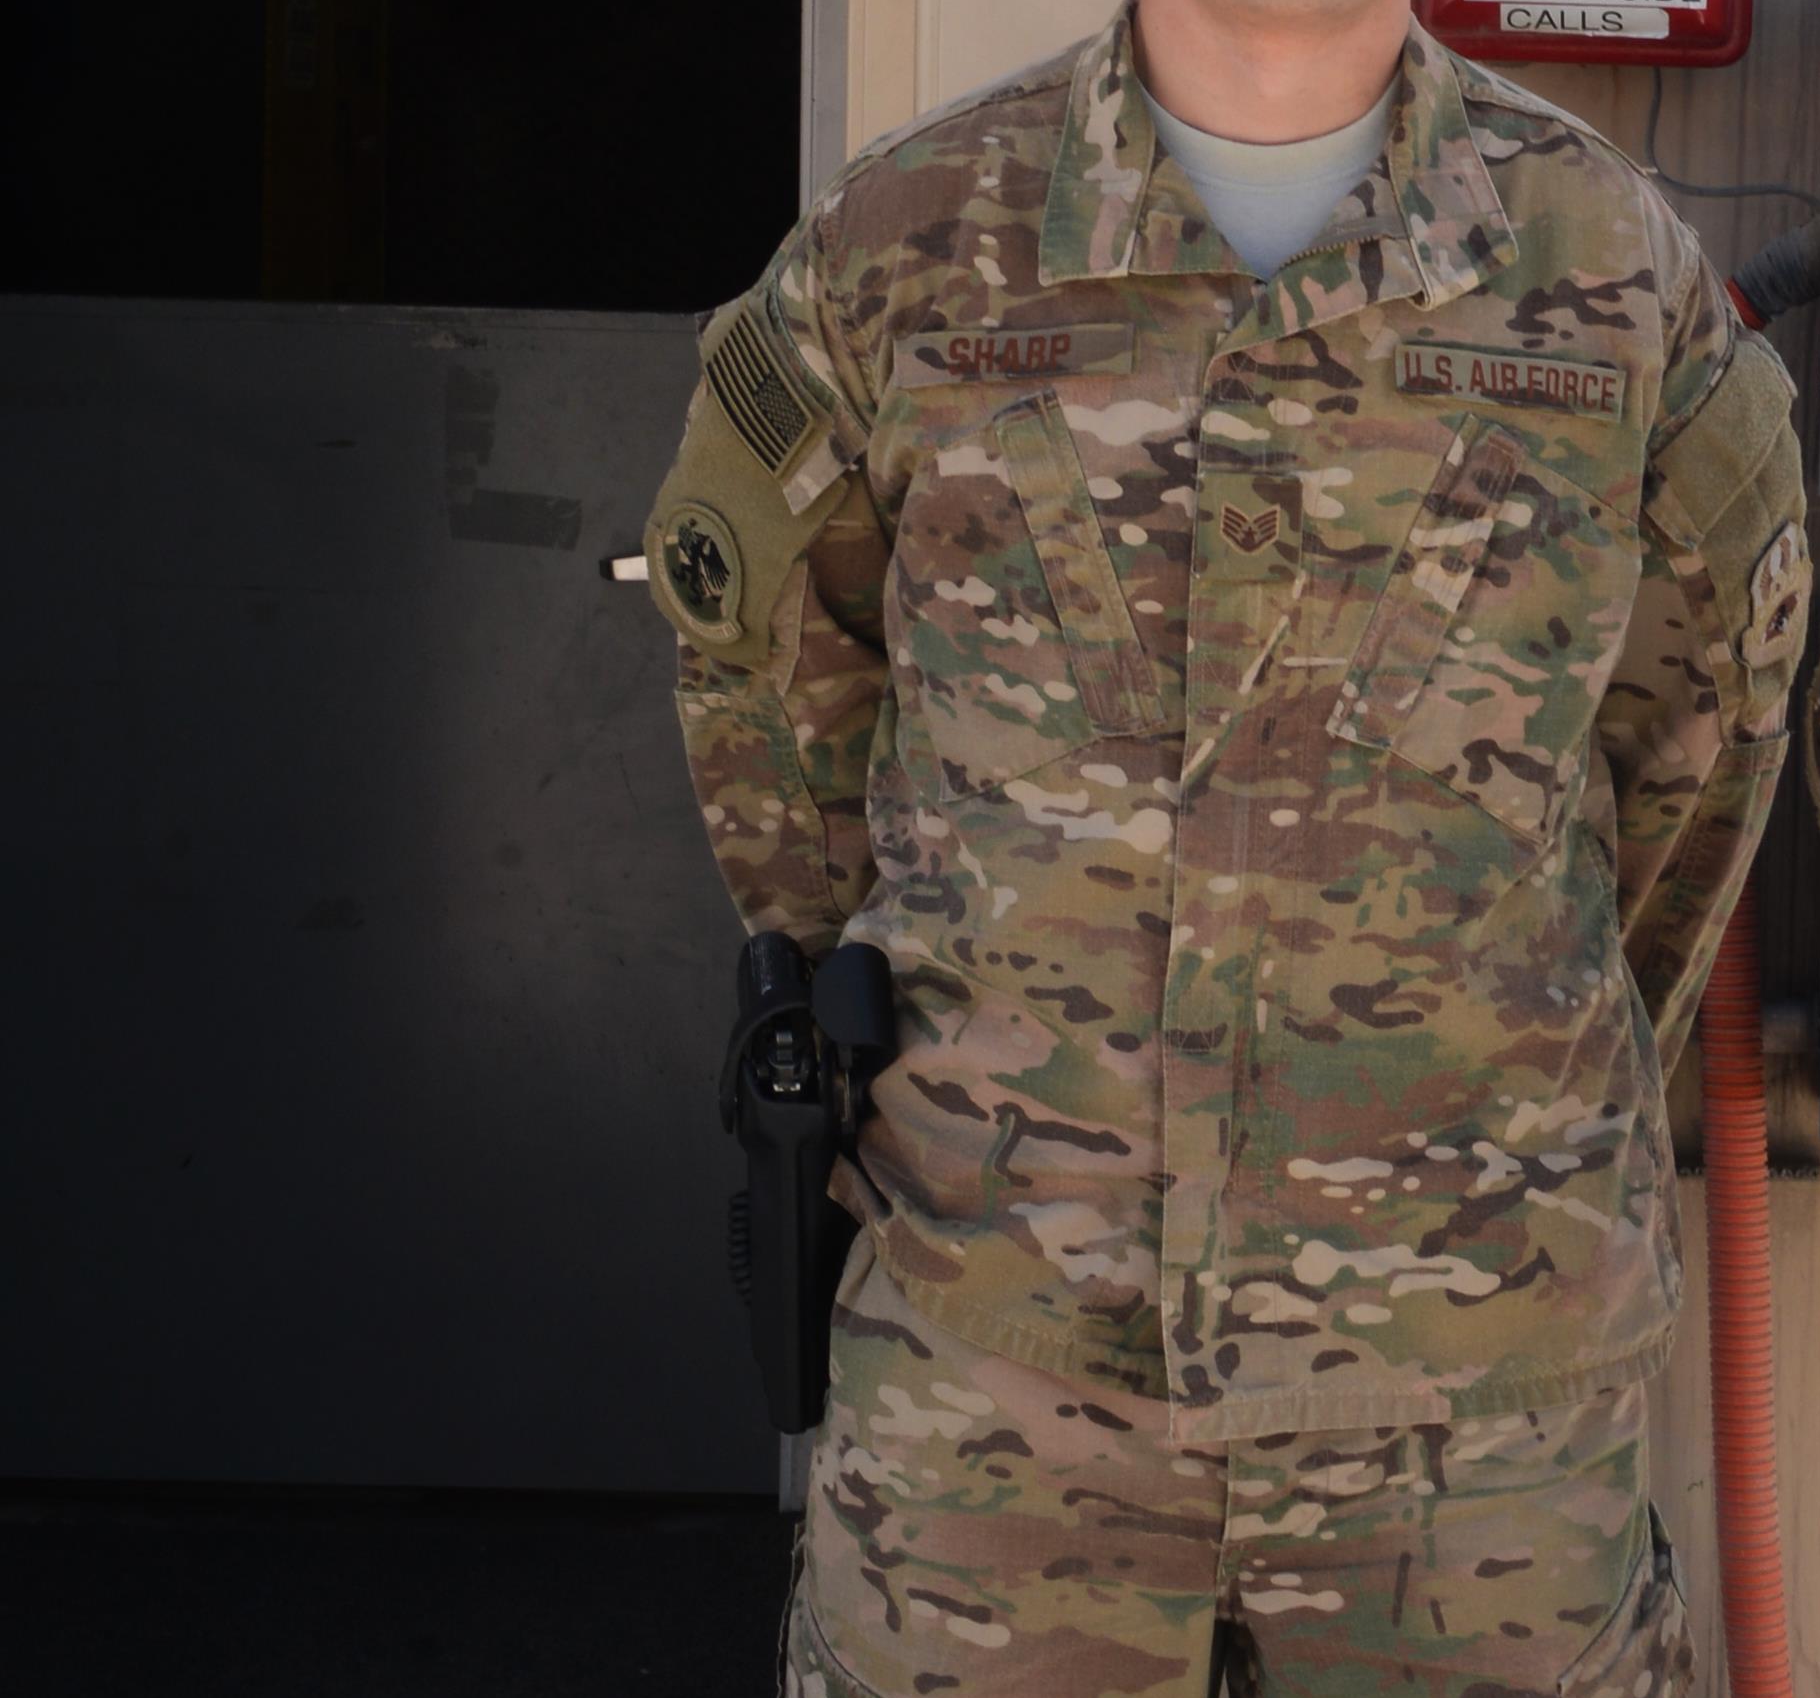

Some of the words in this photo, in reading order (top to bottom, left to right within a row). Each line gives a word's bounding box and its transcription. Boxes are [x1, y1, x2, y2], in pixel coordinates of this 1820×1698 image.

[1506, 8, 1624, 33] CALLS
[947, 333, 1072, 376] SHARP
[1469, 359, 1519, 399] AIR
[1526, 365, 1617, 413] FORCE
